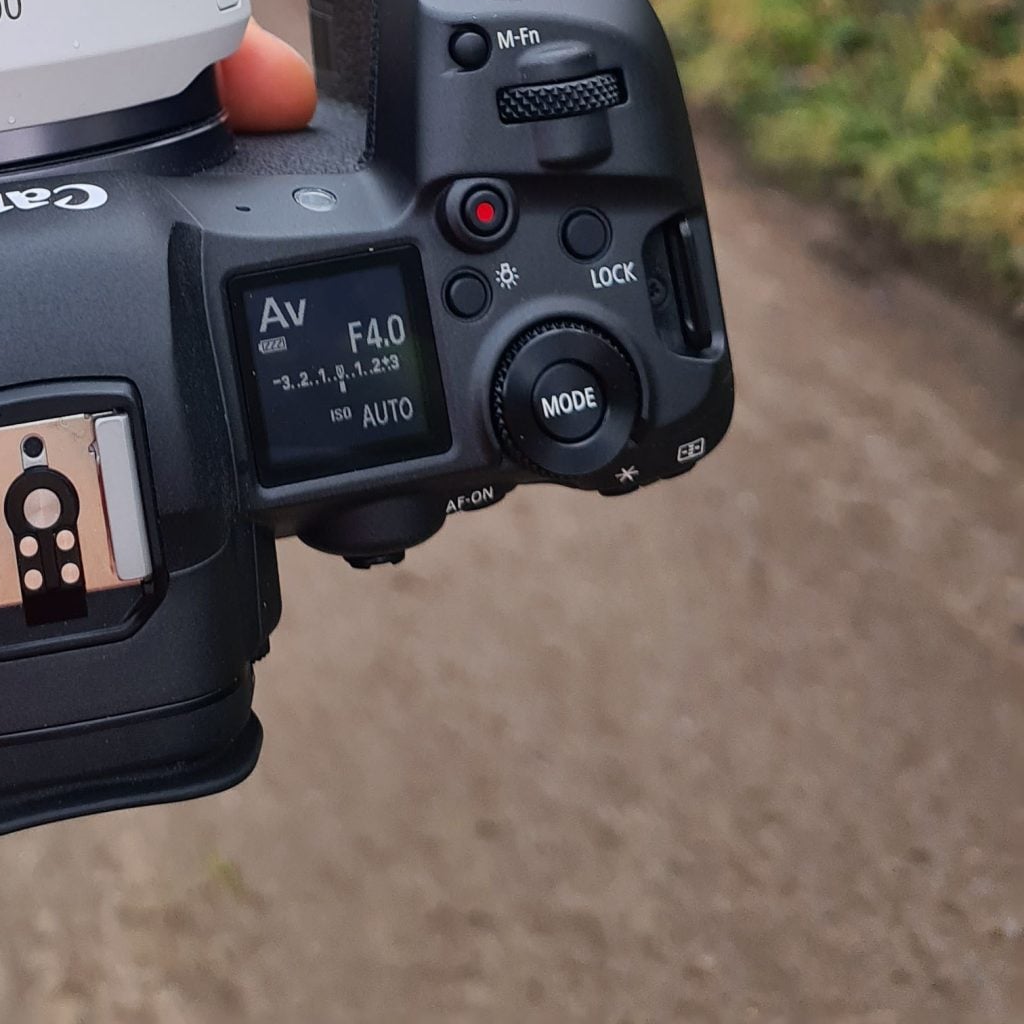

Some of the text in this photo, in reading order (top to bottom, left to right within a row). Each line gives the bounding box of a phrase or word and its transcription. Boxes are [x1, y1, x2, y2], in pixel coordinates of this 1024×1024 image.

[496, 27, 540, 50] M-Fn
[589, 262, 637, 289] LOCK
[259, 296, 307, 333] Av
[347, 314, 406, 354] F4.0
[329, 396, 414, 429] ISO AUTO
[540, 386, 598, 419] MODE
[445, 485, 495, 514] AF-ON
